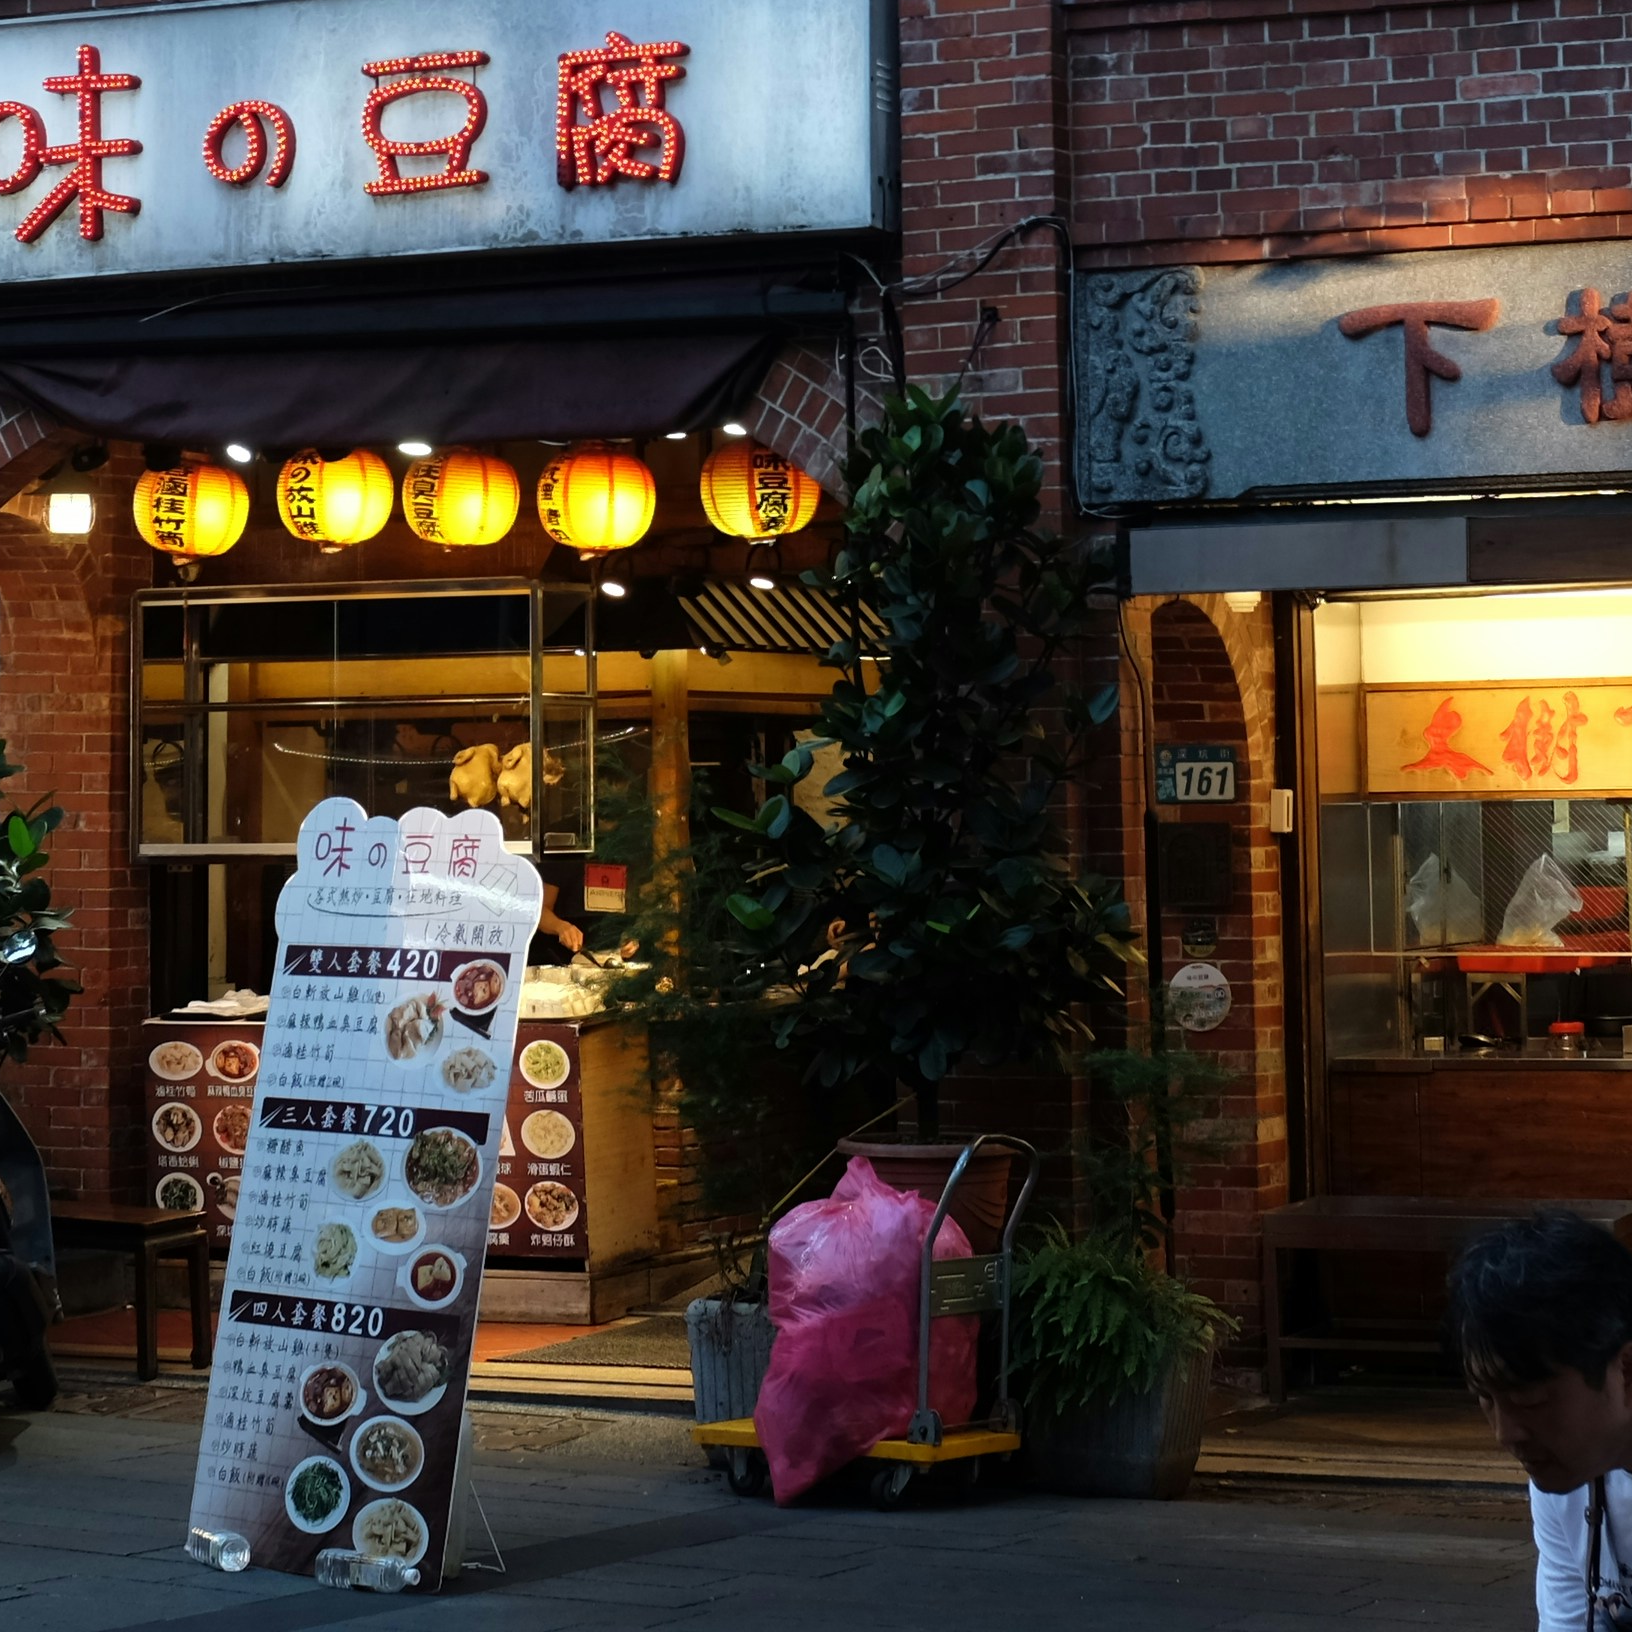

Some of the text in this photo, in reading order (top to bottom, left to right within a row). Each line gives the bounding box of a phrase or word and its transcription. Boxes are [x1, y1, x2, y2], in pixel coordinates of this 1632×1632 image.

[1181, 766, 1228, 796] 161
[314, 817, 481, 879] 味の豆腐
[308, 948, 440, 979] 雙人套餐 420
[281, 1104, 415, 1138] 三人套餐 720
[252, 1300, 384, 1338] 四人套餐 820
